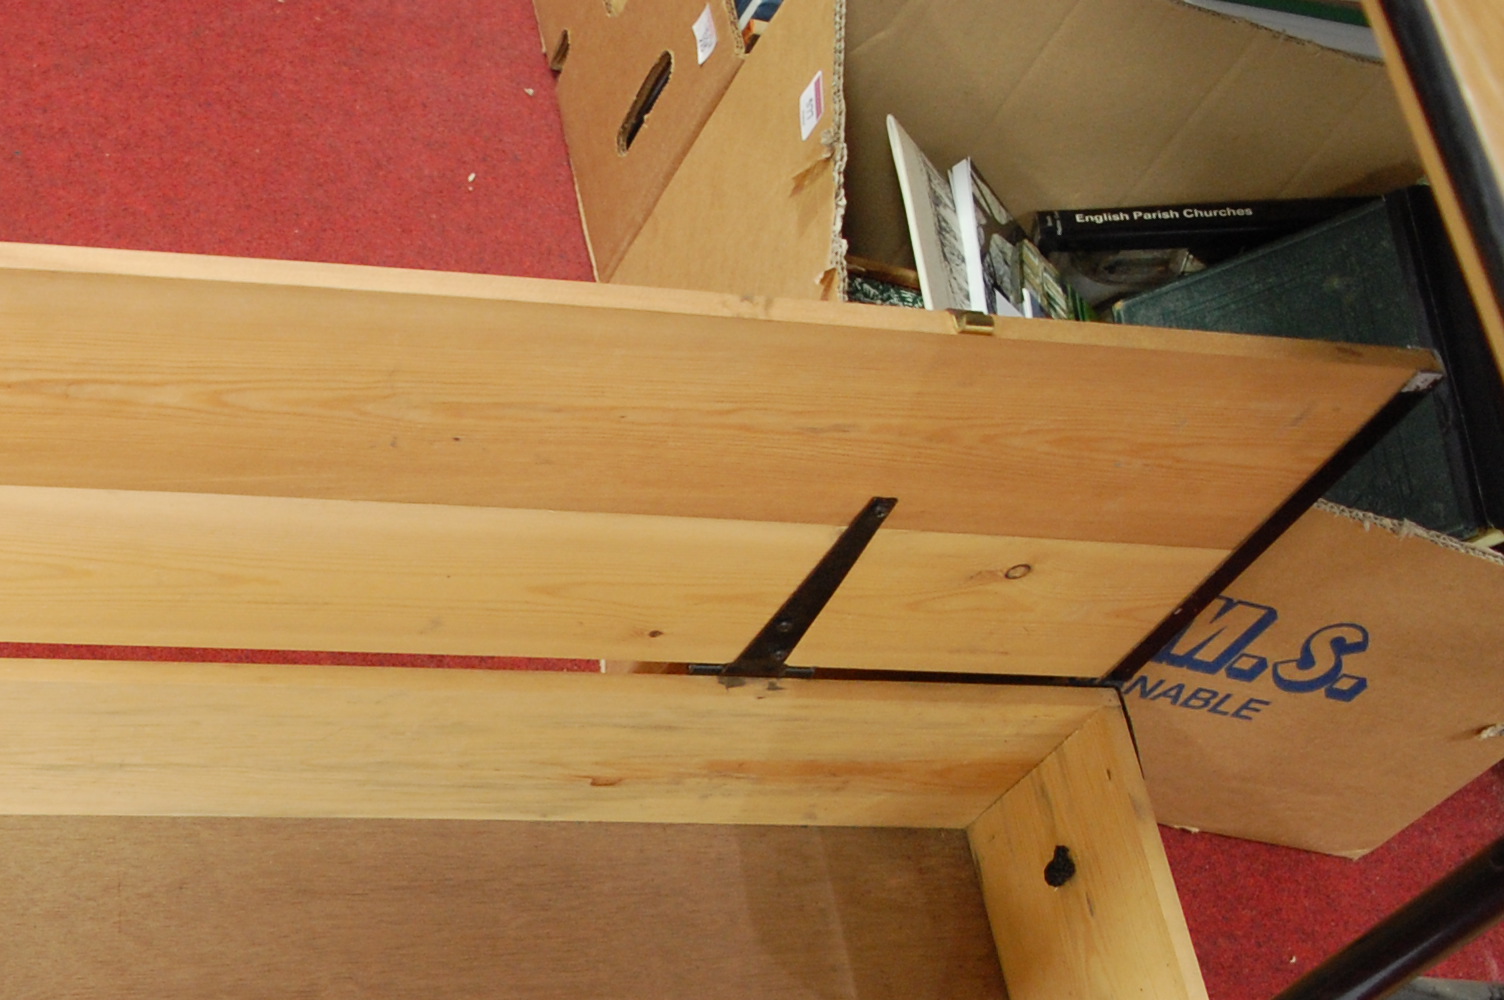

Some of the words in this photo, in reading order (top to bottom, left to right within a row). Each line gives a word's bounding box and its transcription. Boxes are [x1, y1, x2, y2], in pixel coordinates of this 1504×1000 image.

[1075, 211, 1130, 224] English
[1133, 209, 1180, 220] Parish
[1182, 206, 1254, 219] Churches
[1123, 674, 1272, 720] NABLE
